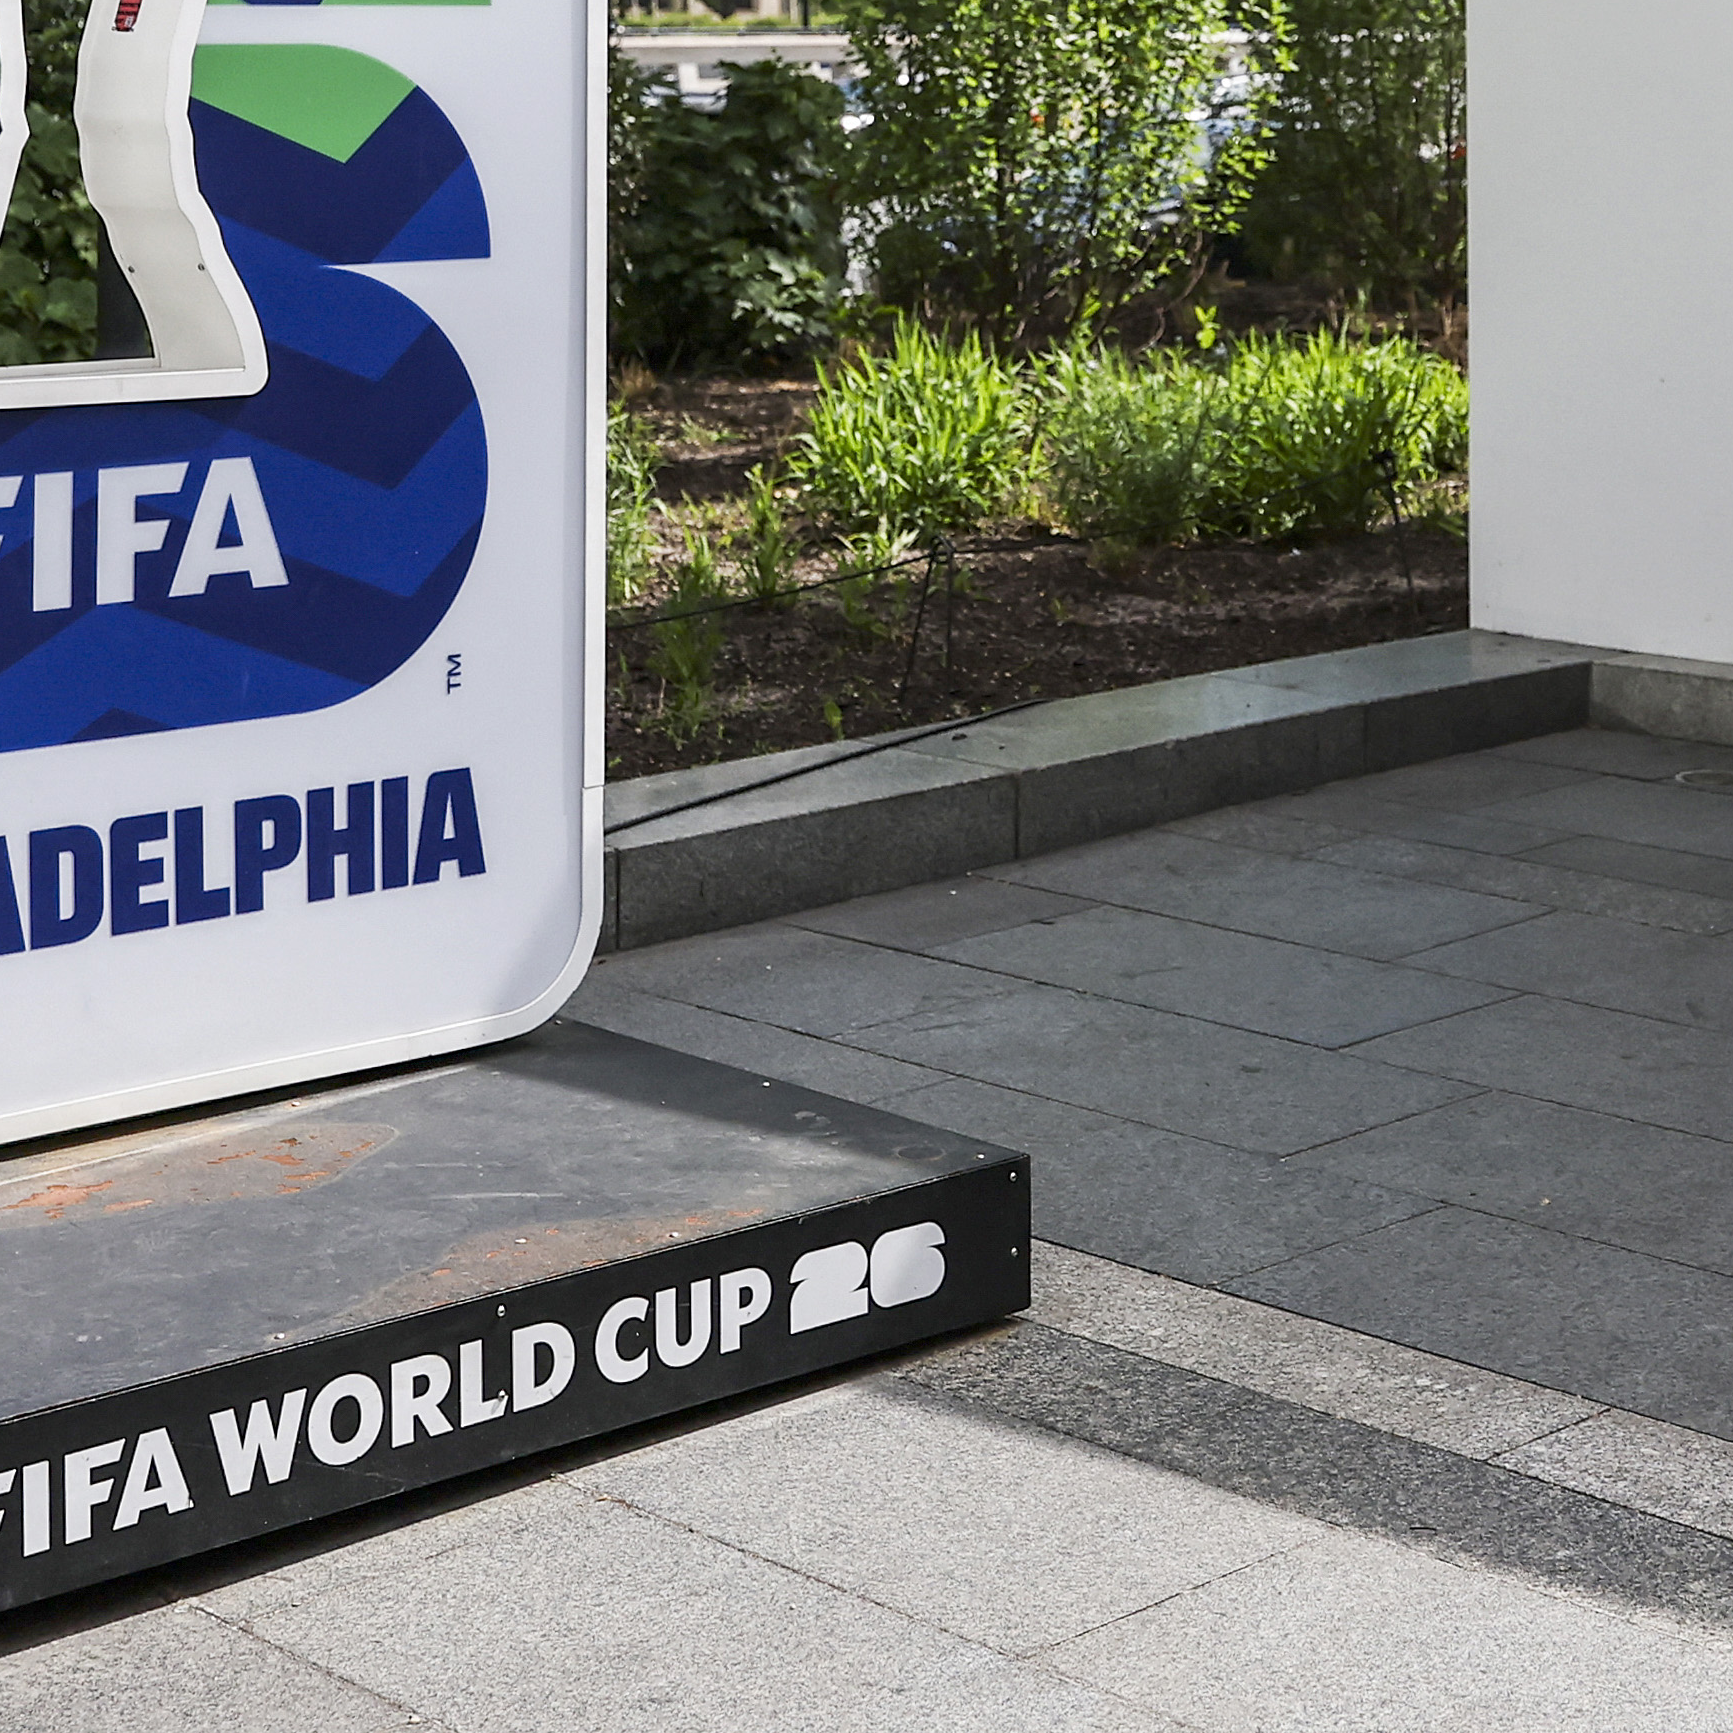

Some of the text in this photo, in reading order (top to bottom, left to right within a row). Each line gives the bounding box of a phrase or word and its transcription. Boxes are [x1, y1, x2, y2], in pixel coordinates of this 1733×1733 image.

[447, 653, 462, 695] TM
[209, 1322, 575, 1495] WORLD
[593, 1267, 773, 1384] CUP
[789, 1220, 947, 1335] 26
